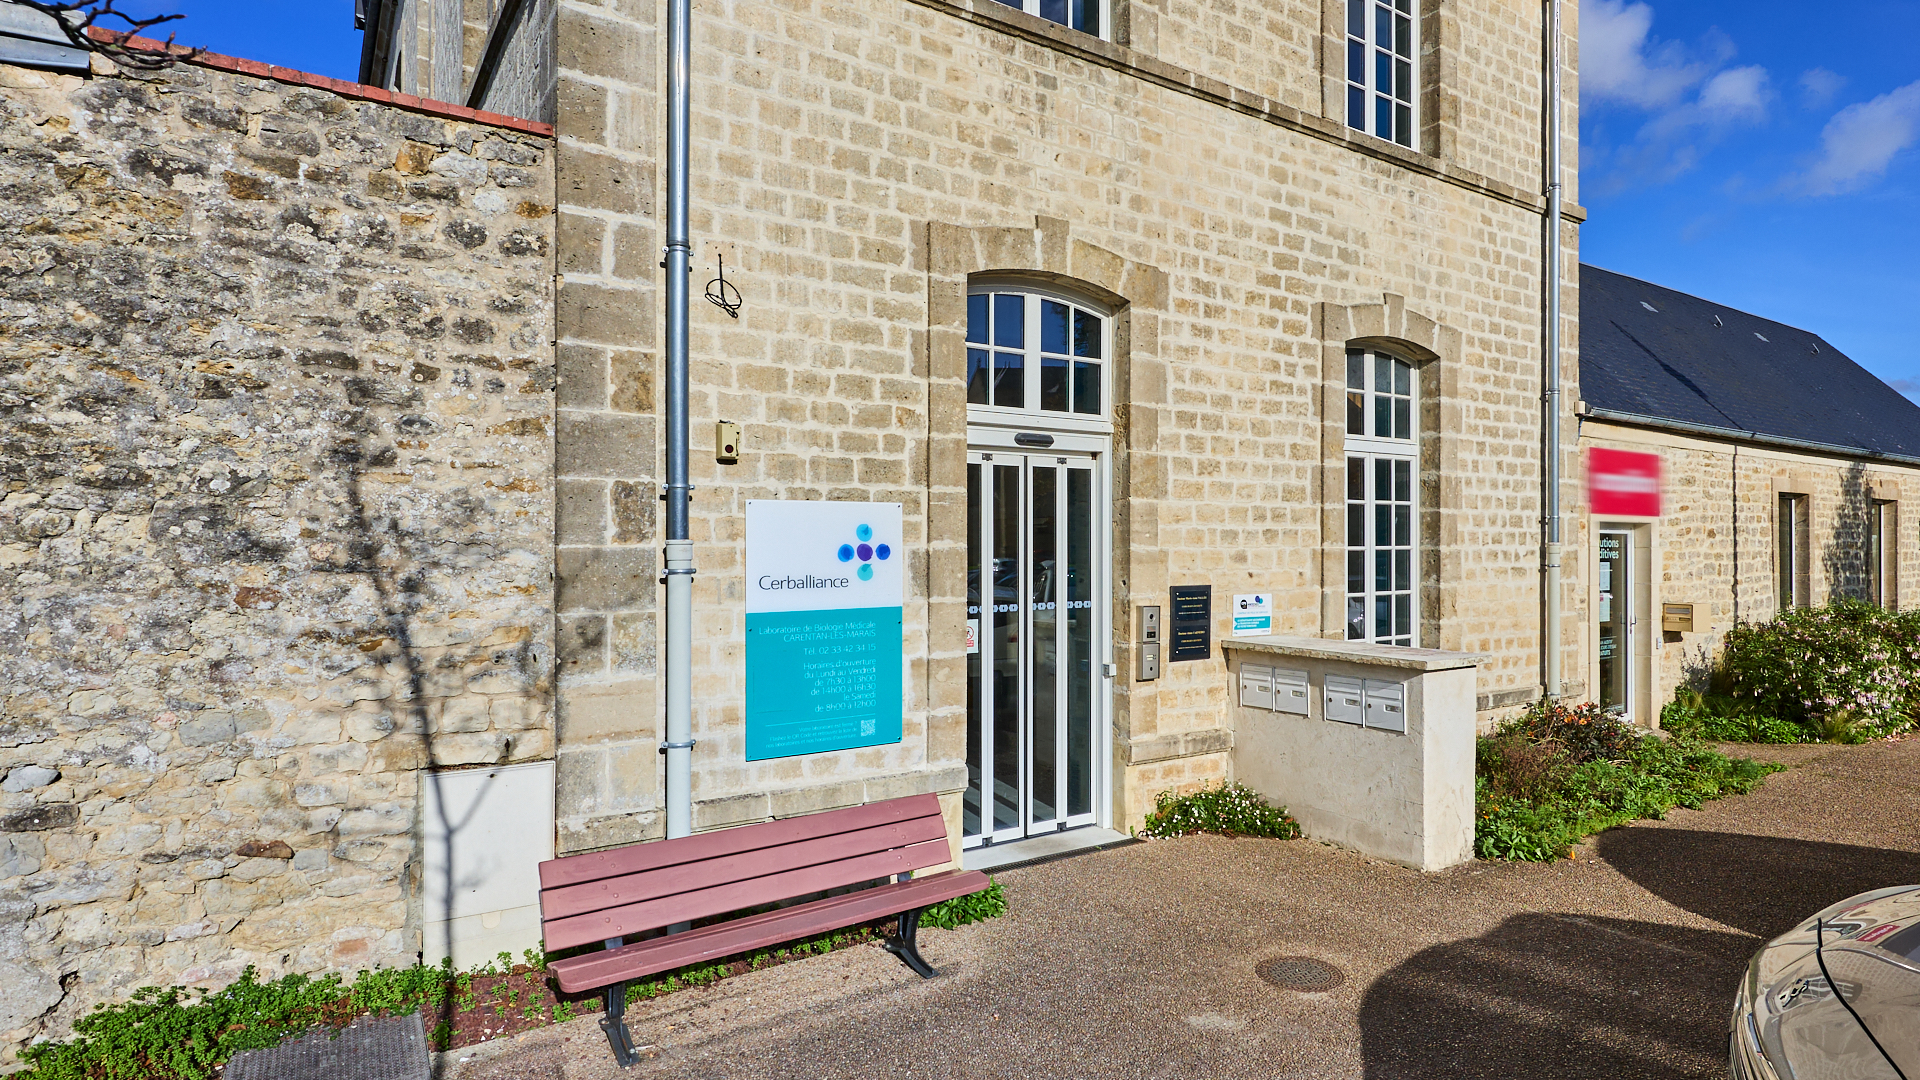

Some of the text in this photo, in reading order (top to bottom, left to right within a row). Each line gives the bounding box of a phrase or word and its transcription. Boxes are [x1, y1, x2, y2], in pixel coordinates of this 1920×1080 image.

[759, 575, 848, 590] Cerballiance
[759, 626, 800, 635] Laboratoire
[815, 623, 843, 632] Biologie
[846, 621, 876, 629] Médicale
[804, 647, 816, 655] Tél.
[804, 658, 876, 670] Horaires d'ouverture
[816, 669, 835, 678] Lundi
[822, 686, 845, 694] 14h00
[854, 683, 876, 691] 16h30
